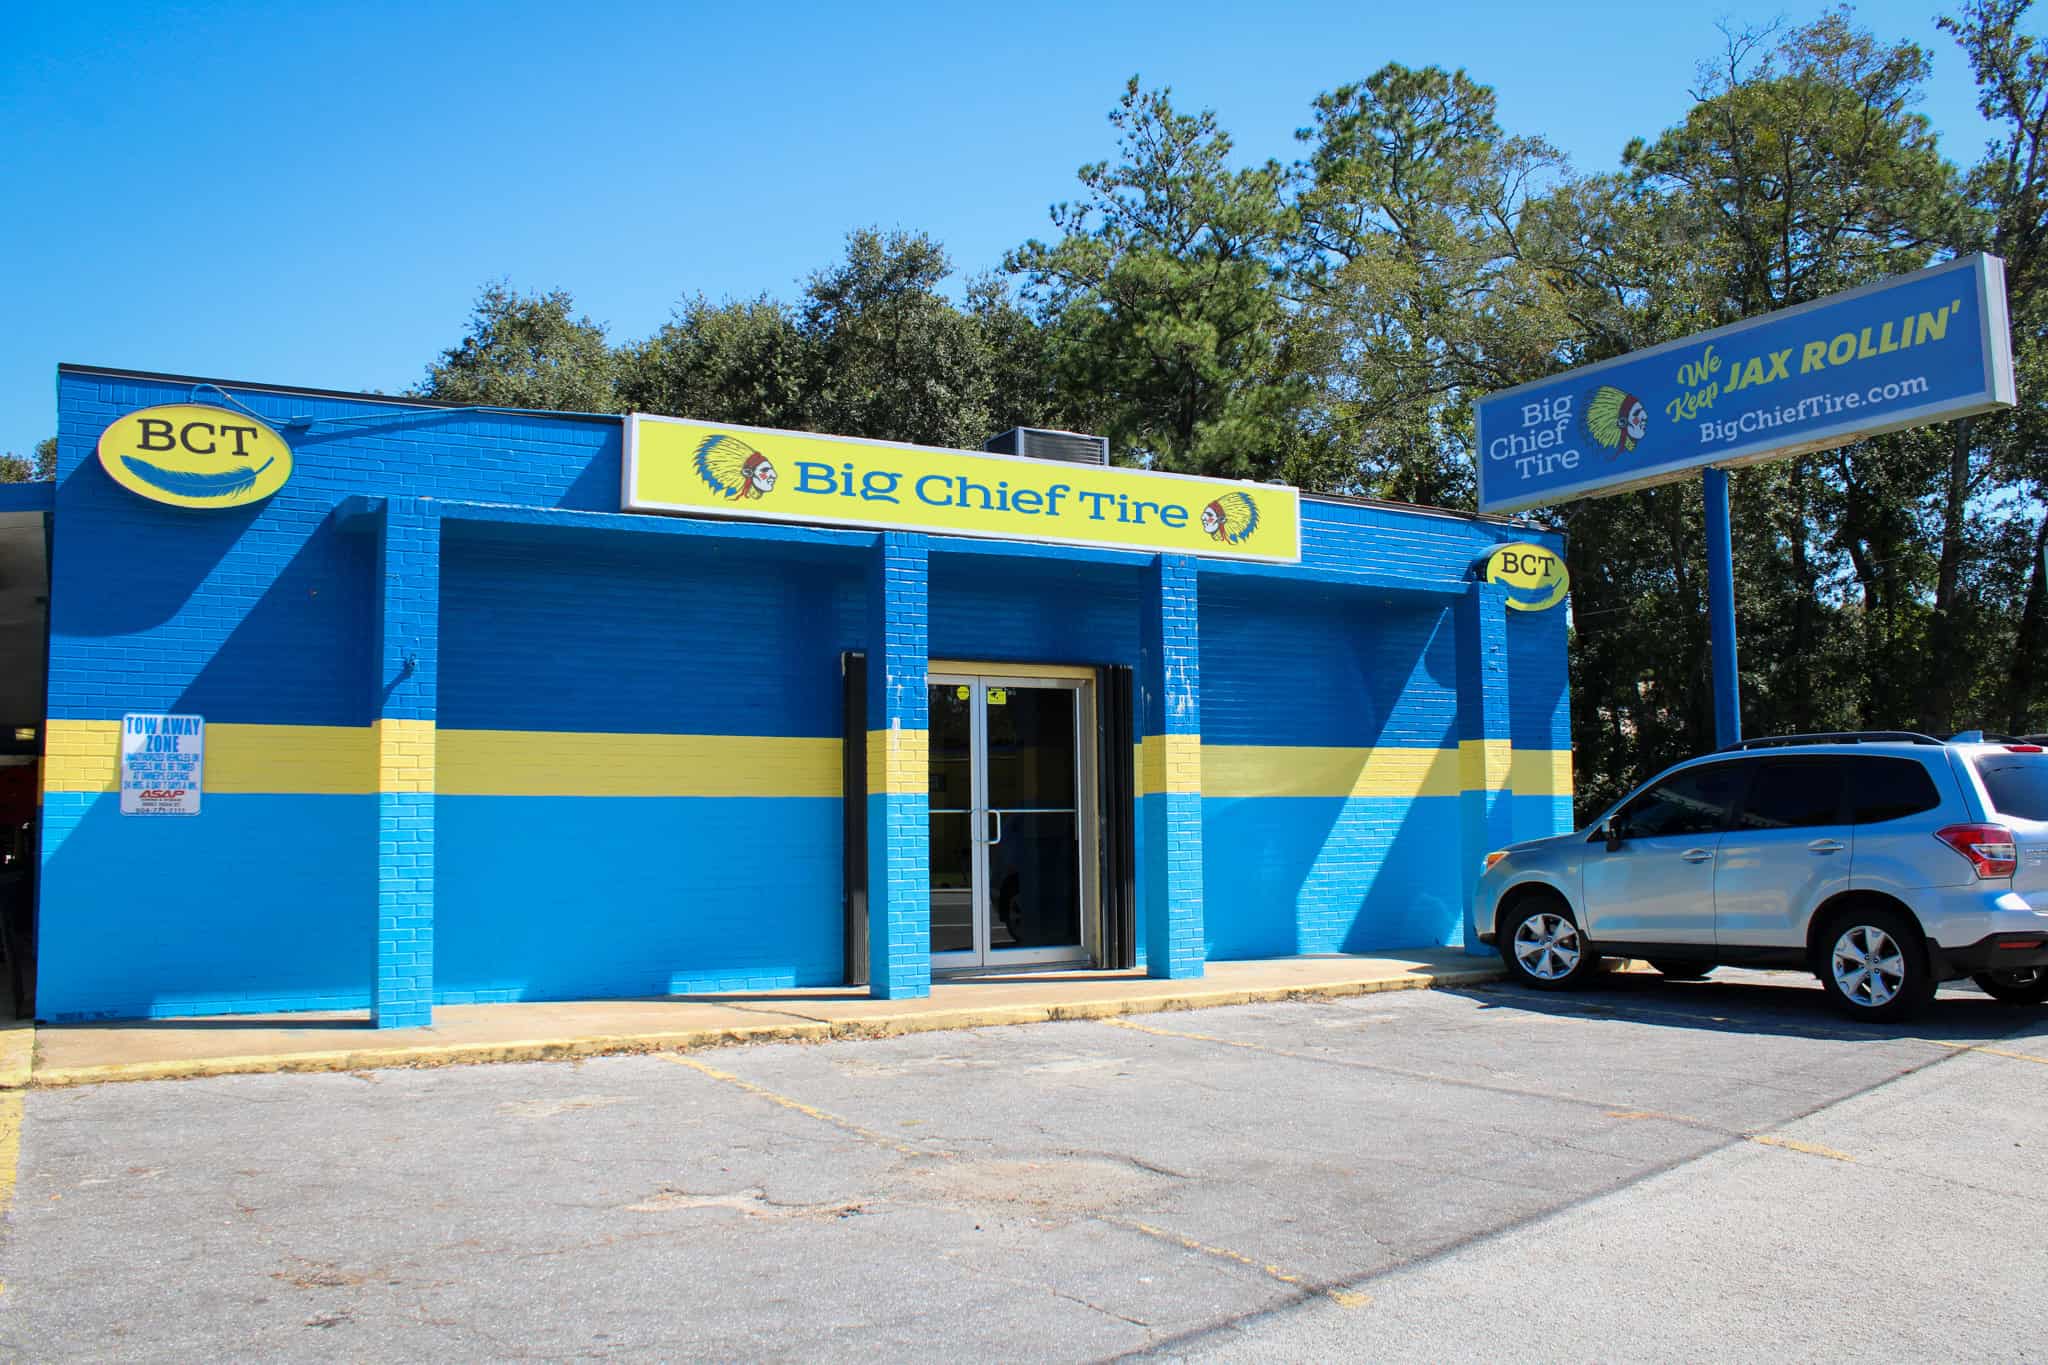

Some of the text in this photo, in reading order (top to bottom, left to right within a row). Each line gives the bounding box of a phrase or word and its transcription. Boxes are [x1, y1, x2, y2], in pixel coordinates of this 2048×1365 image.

[1723, 299, 1961, 393] JAX ROLLIN'
[1676, 345, 1723, 387] We
[1521, 395, 1574, 427] Big
[1665, 382, 1719, 423] Keep
[1700, 376, 1929, 443] BigChiefTire.com
[136, 418, 258, 456] BCT
[1490, 418, 1569, 460] Chief
[1515, 449, 1580, 480] Tire
[793, 461, 1189, 529] Big Chief Tire
[1501, 551, 1556, 577] BCT
[126, 717, 200, 736] TOW AWAY
[146, 735, 179, 752] ZONE
[139, 790, 185, 798] ASAP
